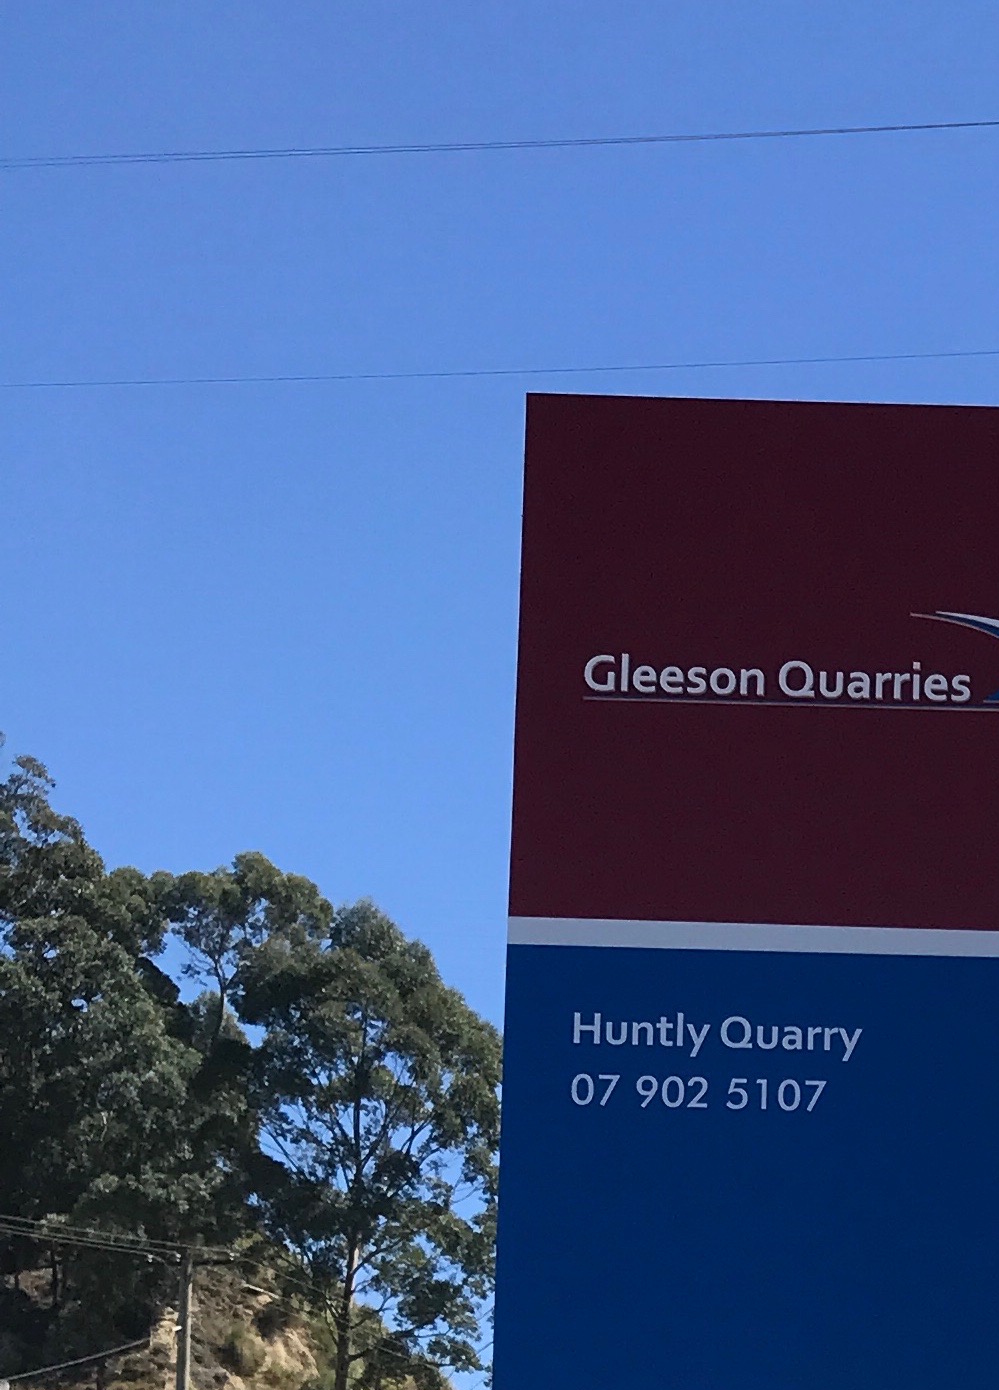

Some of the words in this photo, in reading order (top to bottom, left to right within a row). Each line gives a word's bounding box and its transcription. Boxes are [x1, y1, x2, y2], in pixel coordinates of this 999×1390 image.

[584, 653, 765, 697] Gleeson
[778, 661, 971, 702] Quarries
[573, 1012, 711, 1057] Huntly
[720, 1016, 863, 1062] Quarry
[570, 1073, 621, 1106] 07
[635, 1075, 708, 1109] 902
[726, 1078, 827, 1112] 5107
